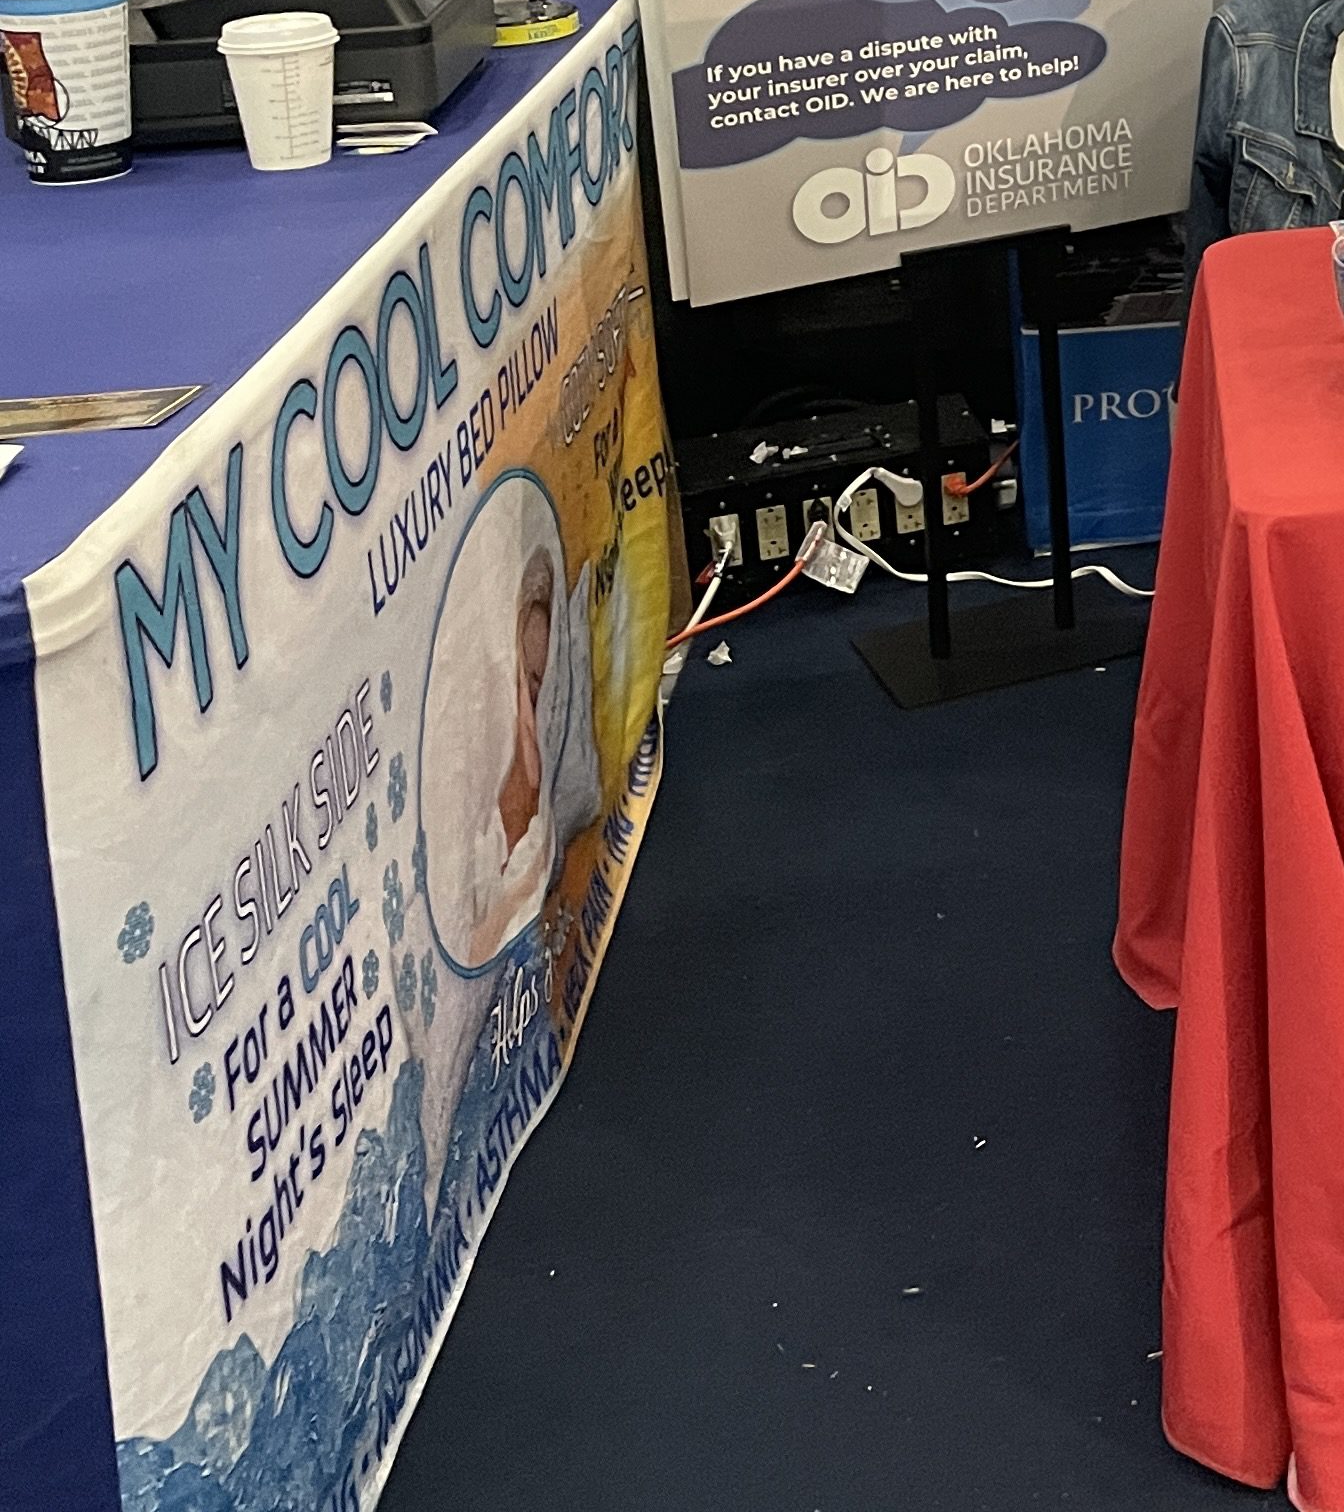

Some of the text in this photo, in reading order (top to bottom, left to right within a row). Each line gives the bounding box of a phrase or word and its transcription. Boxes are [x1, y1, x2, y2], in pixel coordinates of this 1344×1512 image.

[710, 55, 1079, 129] contact OID. We are here to help!
[964, 117, 1133, 167] OKLAHOMA
[966, 143, 1133, 195] INSURANCE
[966, 168, 1132, 218] DEPARTMENT
[113, 440, 250, 783] MY
[271, 240, 460, 581] COOL
[366, 296, 560, 617] LUXURY BED PILLOW
[156, 678, 381, 1066] ICE SILK SIDE
[220, 862, 360, 1113] For a COOL
[246, 954, 358, 1183] SUMMER
[217, 1004, 394, 1323] Night's Sleep
[473, 1029, 563, 1197] ASTHMA
